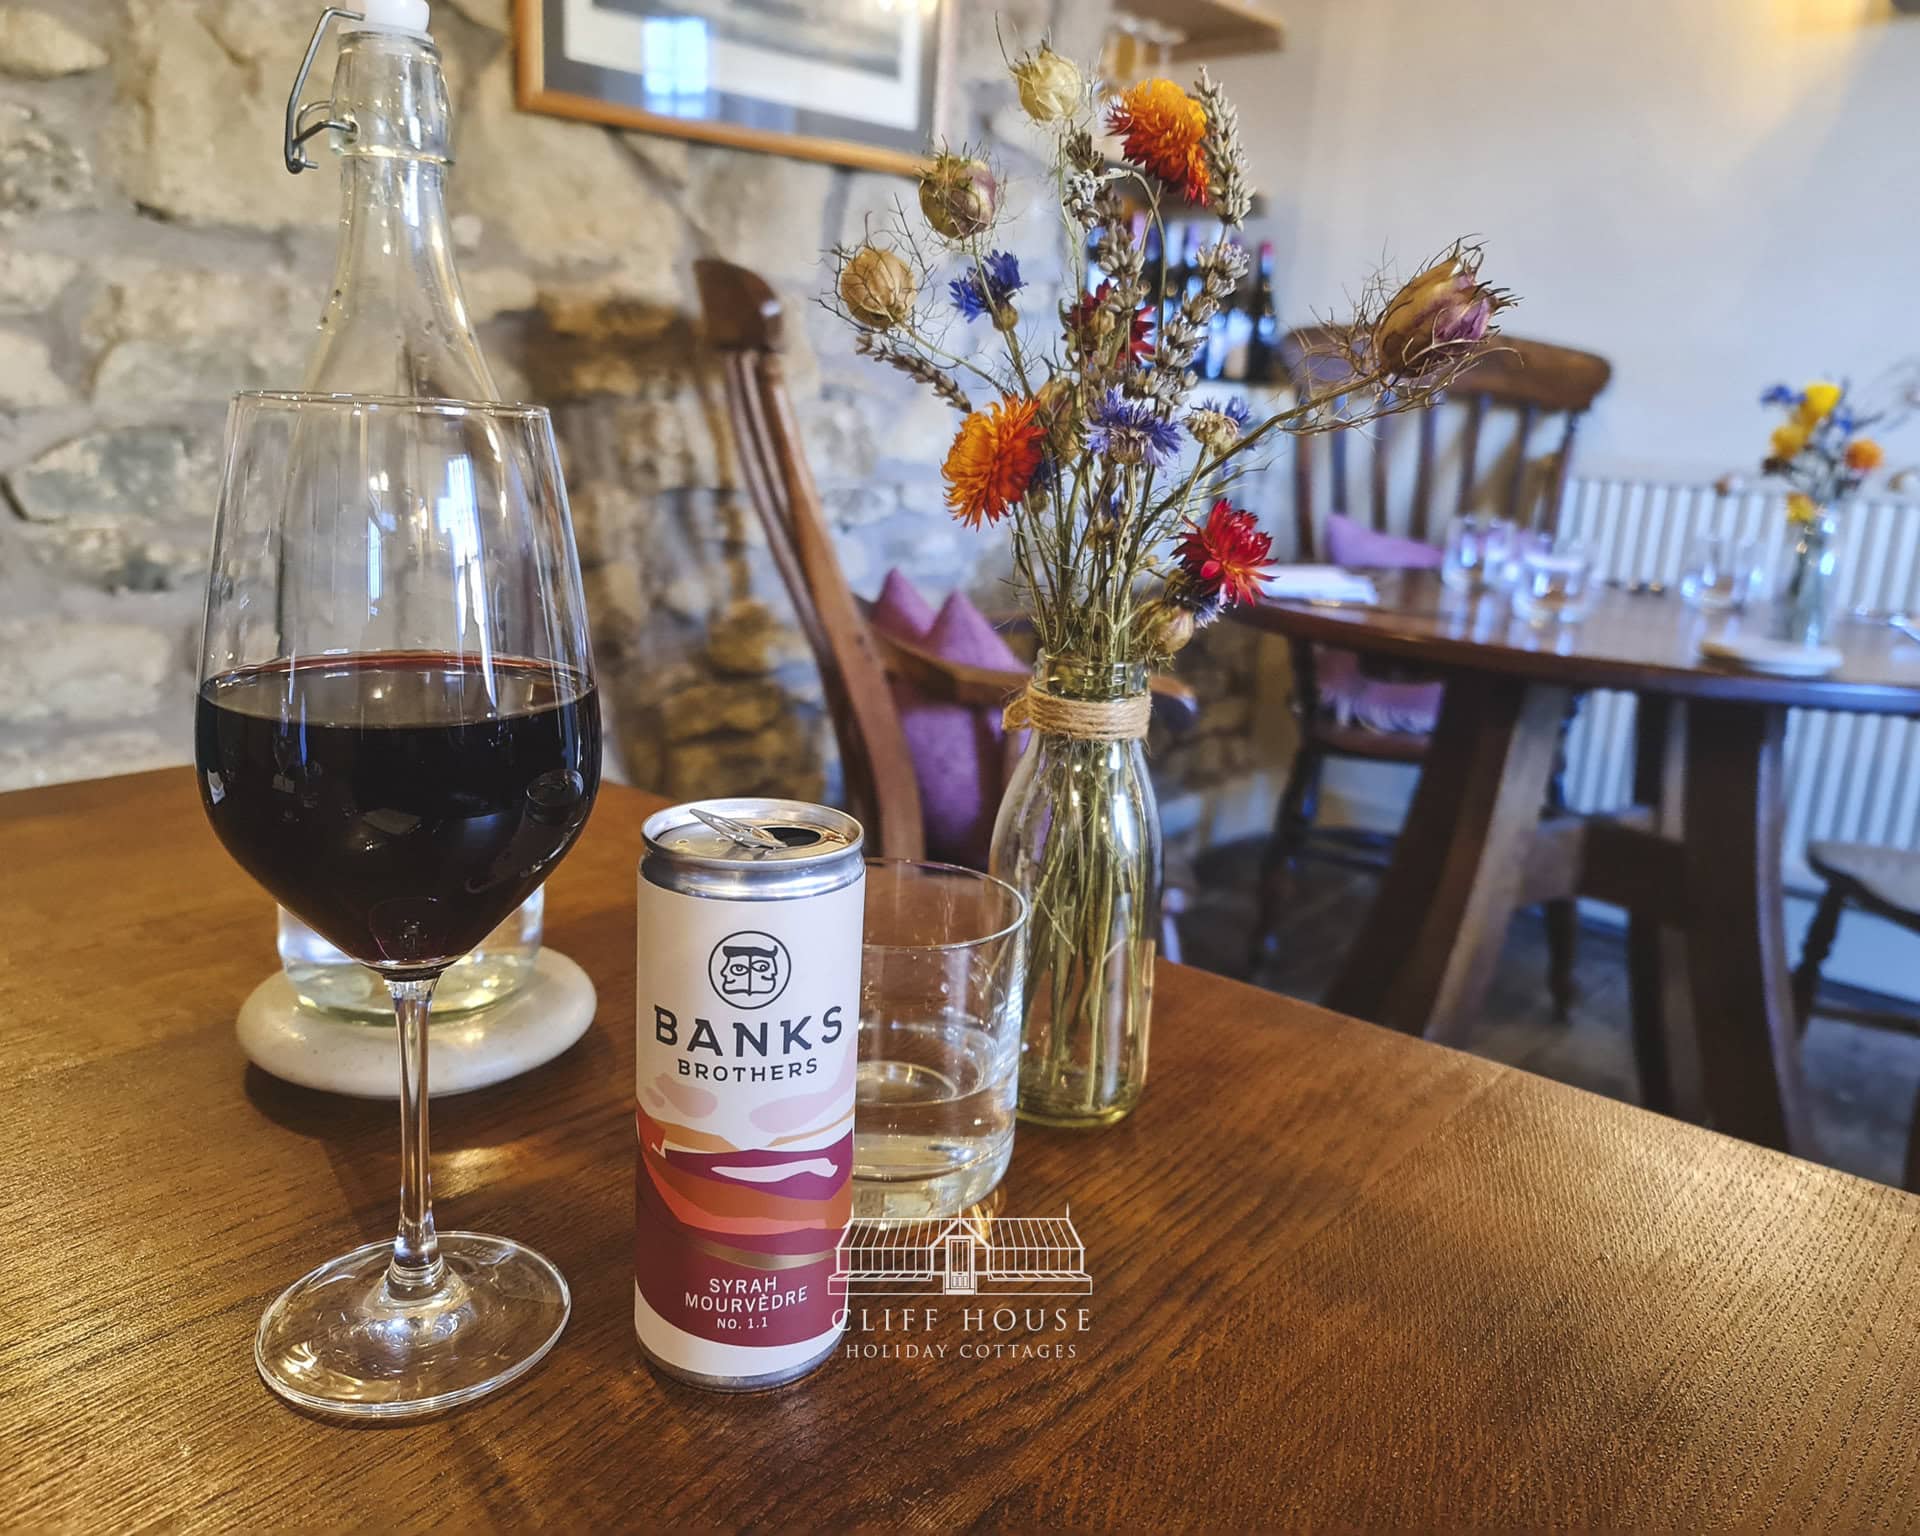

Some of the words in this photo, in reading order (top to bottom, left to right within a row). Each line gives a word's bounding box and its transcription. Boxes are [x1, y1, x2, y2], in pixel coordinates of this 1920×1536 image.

[654, 1004, 842, 1058] BANKS
[677, 1058, 817, 1082] BROTHERS
[709, 1276, 777, 1294] SYRAH
[685, 1286, 808, 1313] MOURVÈDRE
[716, 1318, 742, 1330] NO.
[747, 1317, 768, 1329] 1.1
